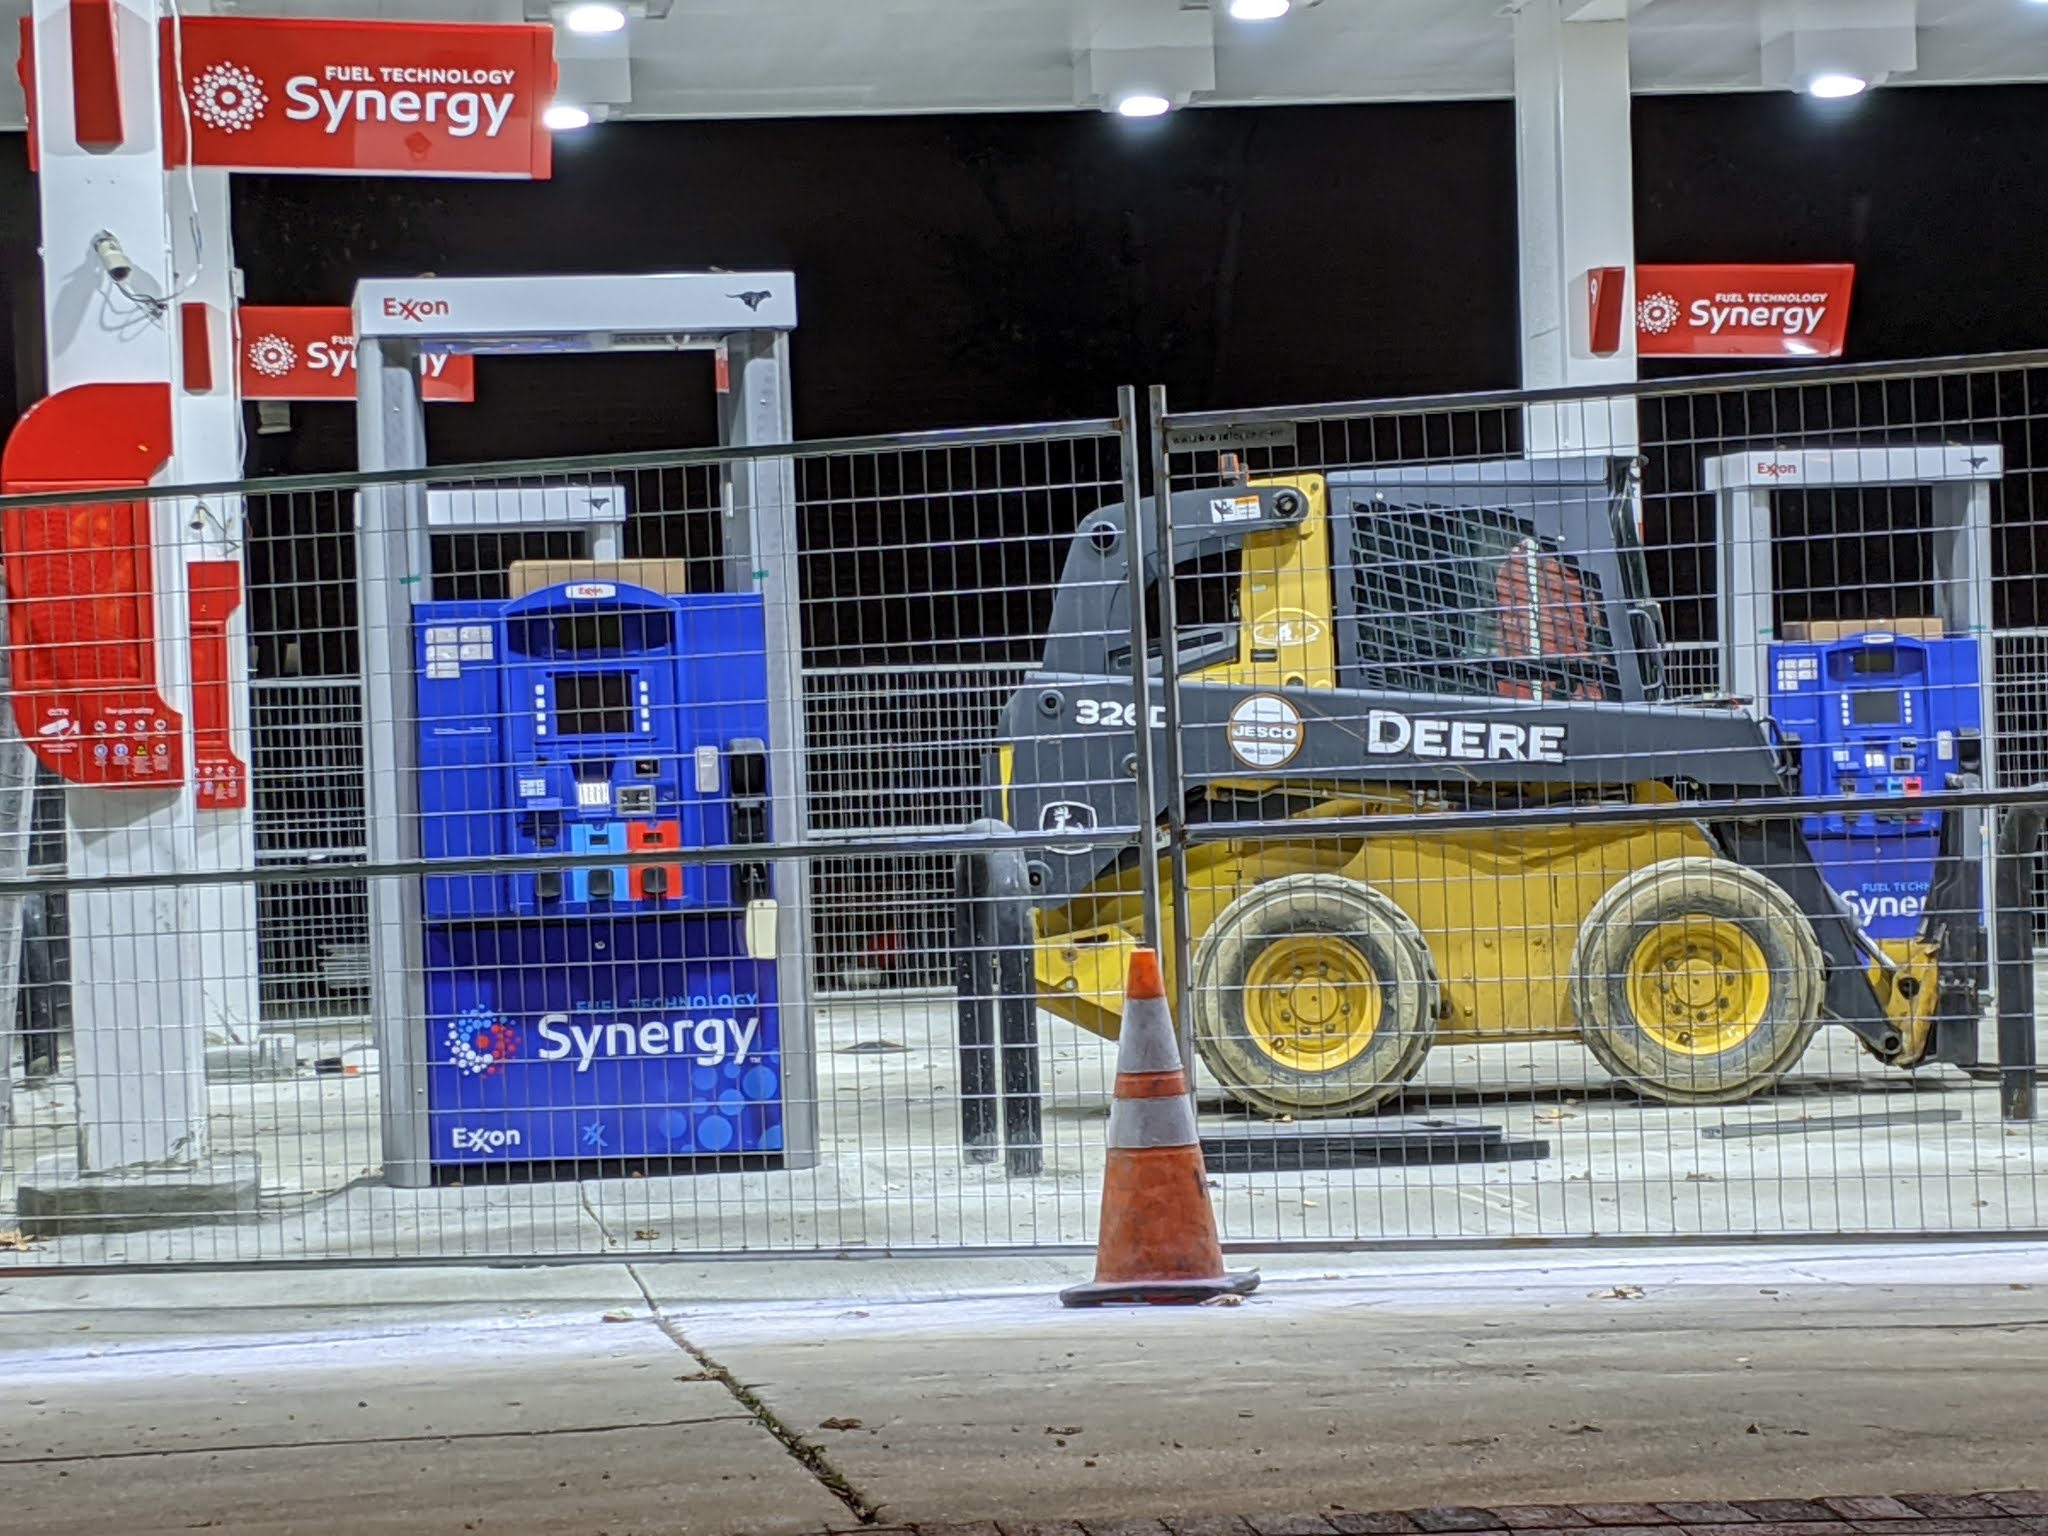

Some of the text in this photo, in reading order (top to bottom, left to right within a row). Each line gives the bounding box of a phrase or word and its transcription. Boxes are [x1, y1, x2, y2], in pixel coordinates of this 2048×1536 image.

[325, 65, 515, 84] FUEL TECHNOLOGY
[285, 75, 516, 138] Synergy
[383, 297, 450, 322] Exxon
[1714, 293, 1828, 304] FUEL TECHNOLOGY
[1689, 299, 1826, 335] Synergy
[1757, 462, 1797, 478] Exxon
[1232, 724, 1298, 740] JESCO
[1367, 709, 1566, 763] DEERE
[1861, 881, 1930, 893] FUEL TECHN
[1840, 890, 1928, 927] Syner
[576, 991, 758, 1013] FUE TECHNOLOGY
[538, 1013, 760, 1072] Synergy
[452, 1127, 521, 1153] Exxon
